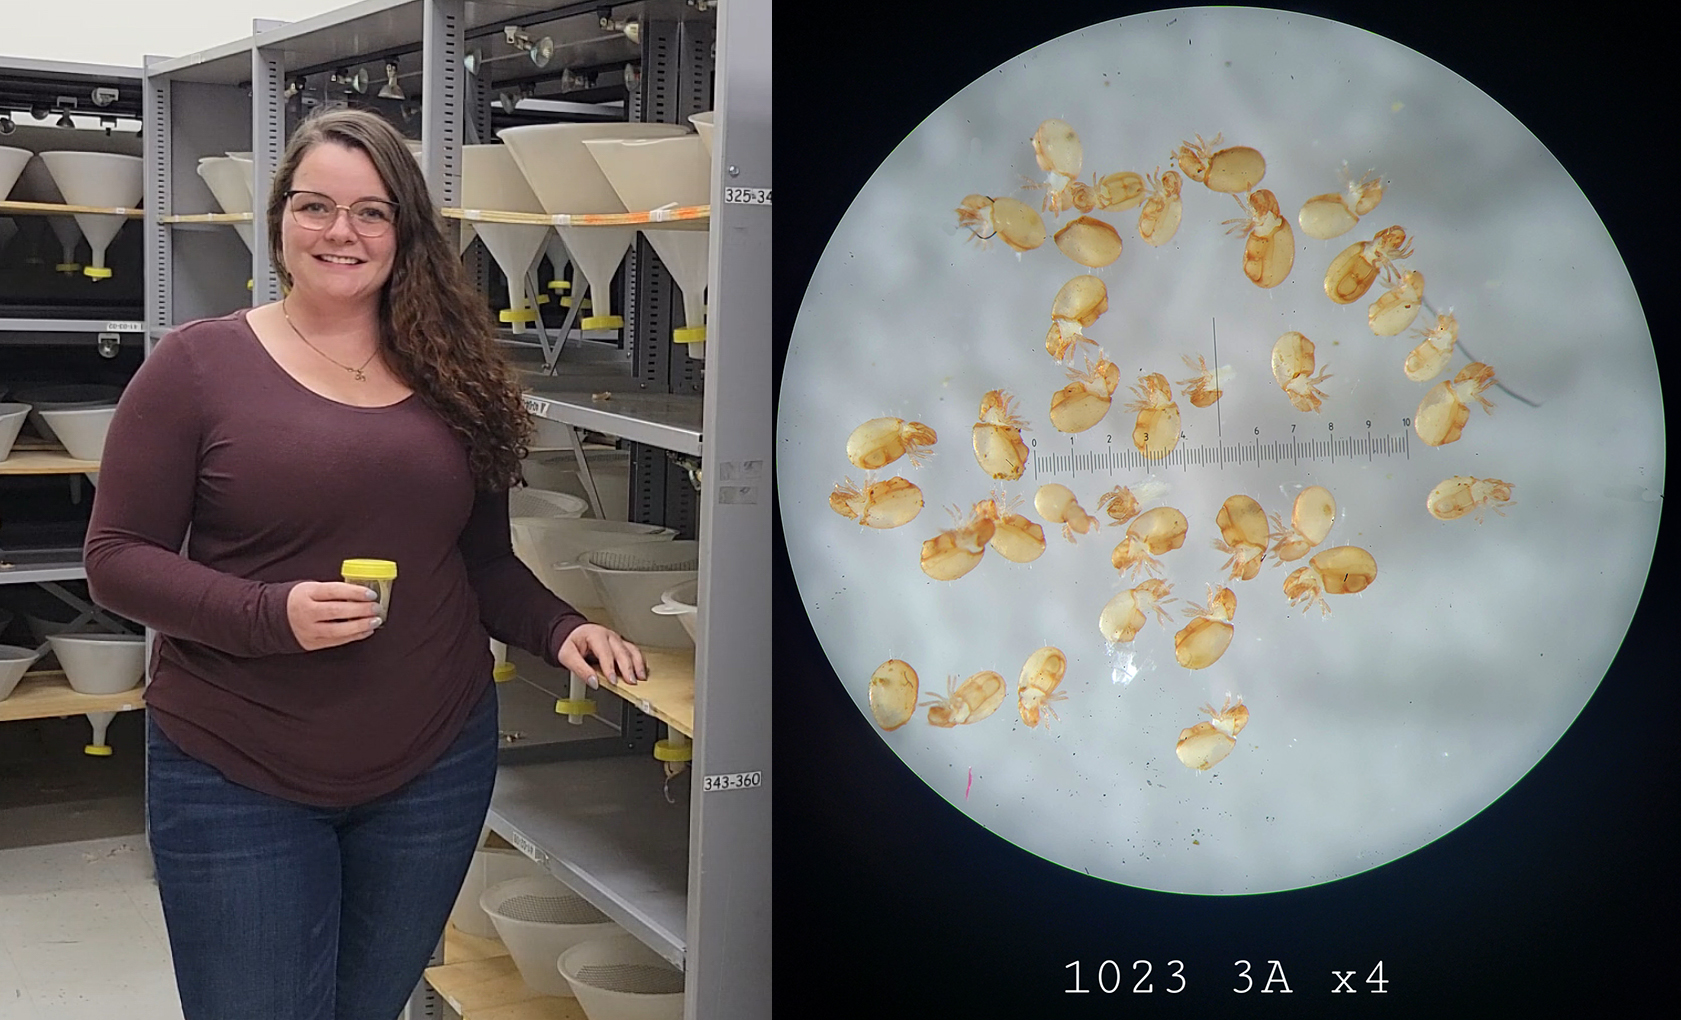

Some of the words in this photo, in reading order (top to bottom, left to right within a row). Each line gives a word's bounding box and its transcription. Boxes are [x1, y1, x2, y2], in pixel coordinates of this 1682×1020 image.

[1032, 438, 1037, 447] 0
[1107, 435, 1112, 443] 2
[1144, 433, 1149, 442] 3
[1254, 427, 1259, 435] 6
[1291, 424, 1296, 433] 7
[1328, 422, 1334, 431] 8
[1366, 420, 1371, 428] 9
[1402, 418, 1411, 427] 10
[704, 772, 761, 790] 343-360
